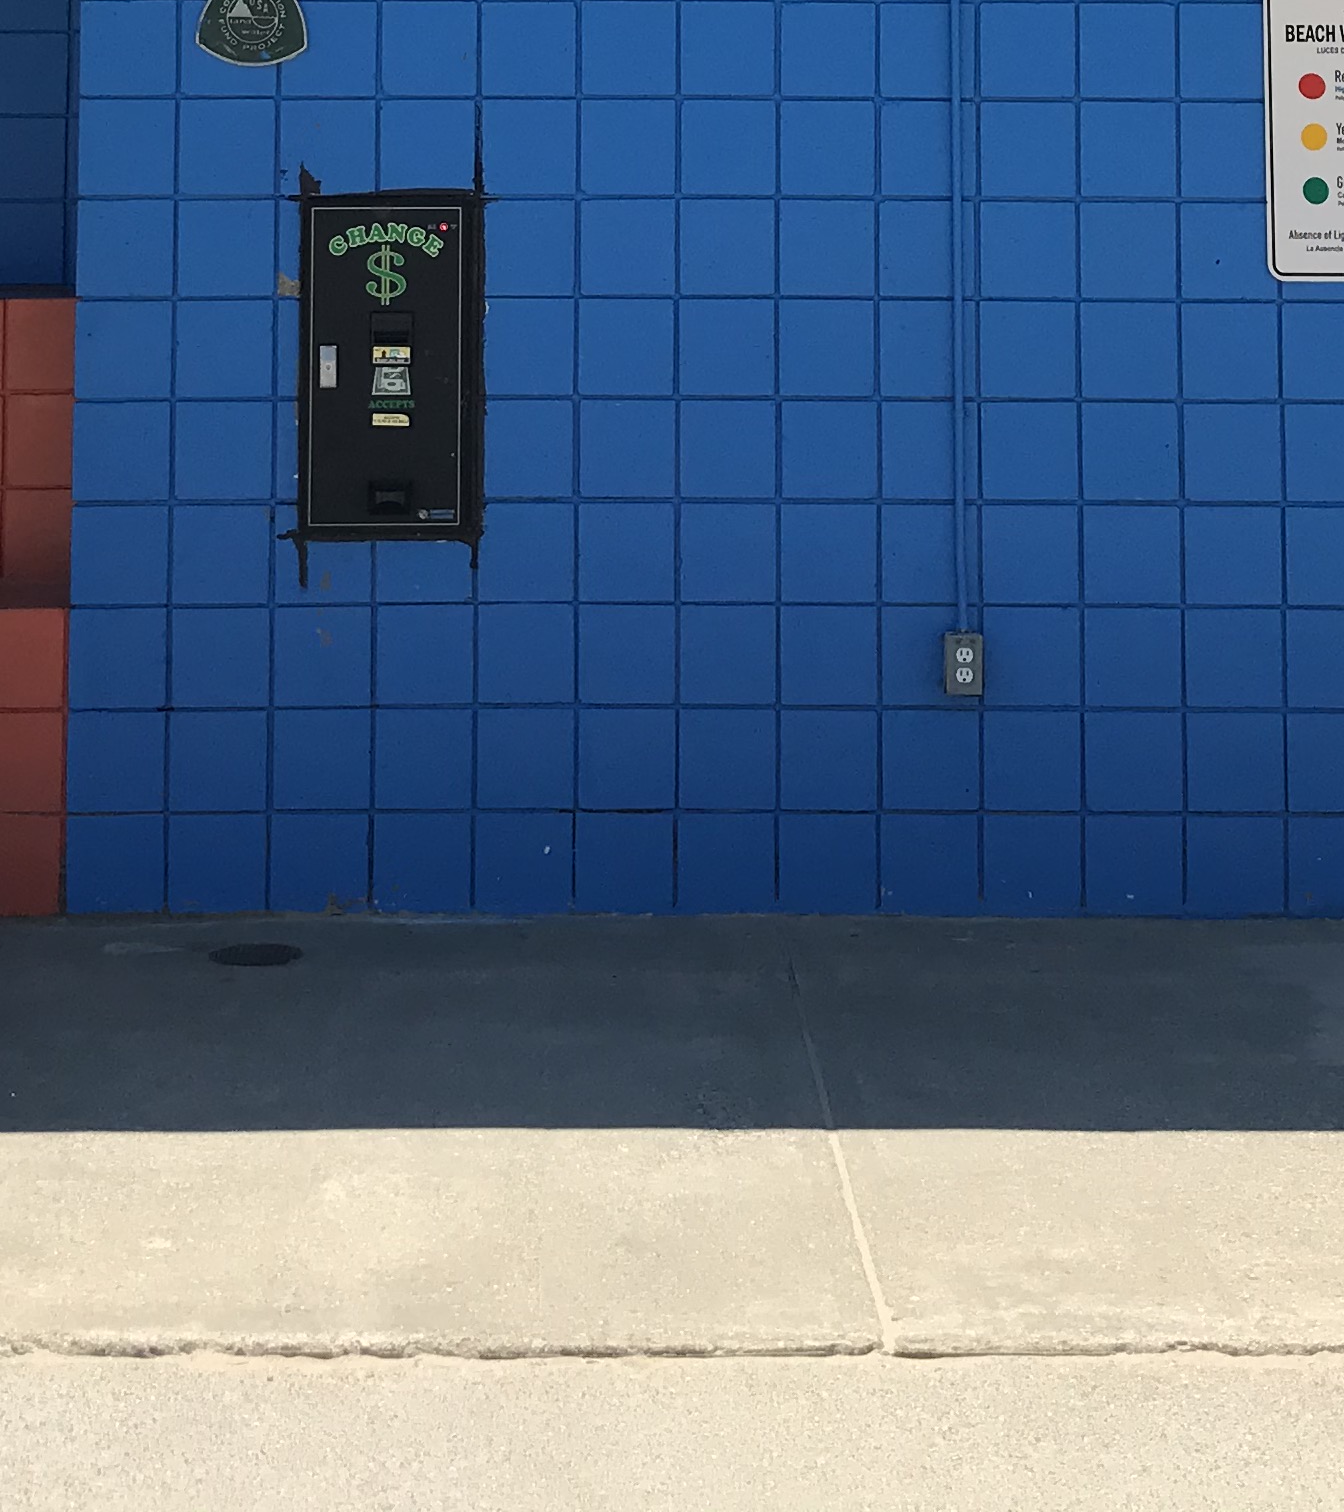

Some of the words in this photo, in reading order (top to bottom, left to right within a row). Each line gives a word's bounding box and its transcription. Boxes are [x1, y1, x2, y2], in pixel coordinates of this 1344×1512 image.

[219, 19, 238, 45] FUND
[242, 23, 285, 50] PROJECT
[1285, 24, 1336, 42] BEACH
[328, 222, 444, 258] CHANGE
[1288, 230, 1322, 239] Absence
[1324, 230, 1332, 239] of
[365, 244, 407, 306] $
[368, 399, 416, 409] ACCEPTS
